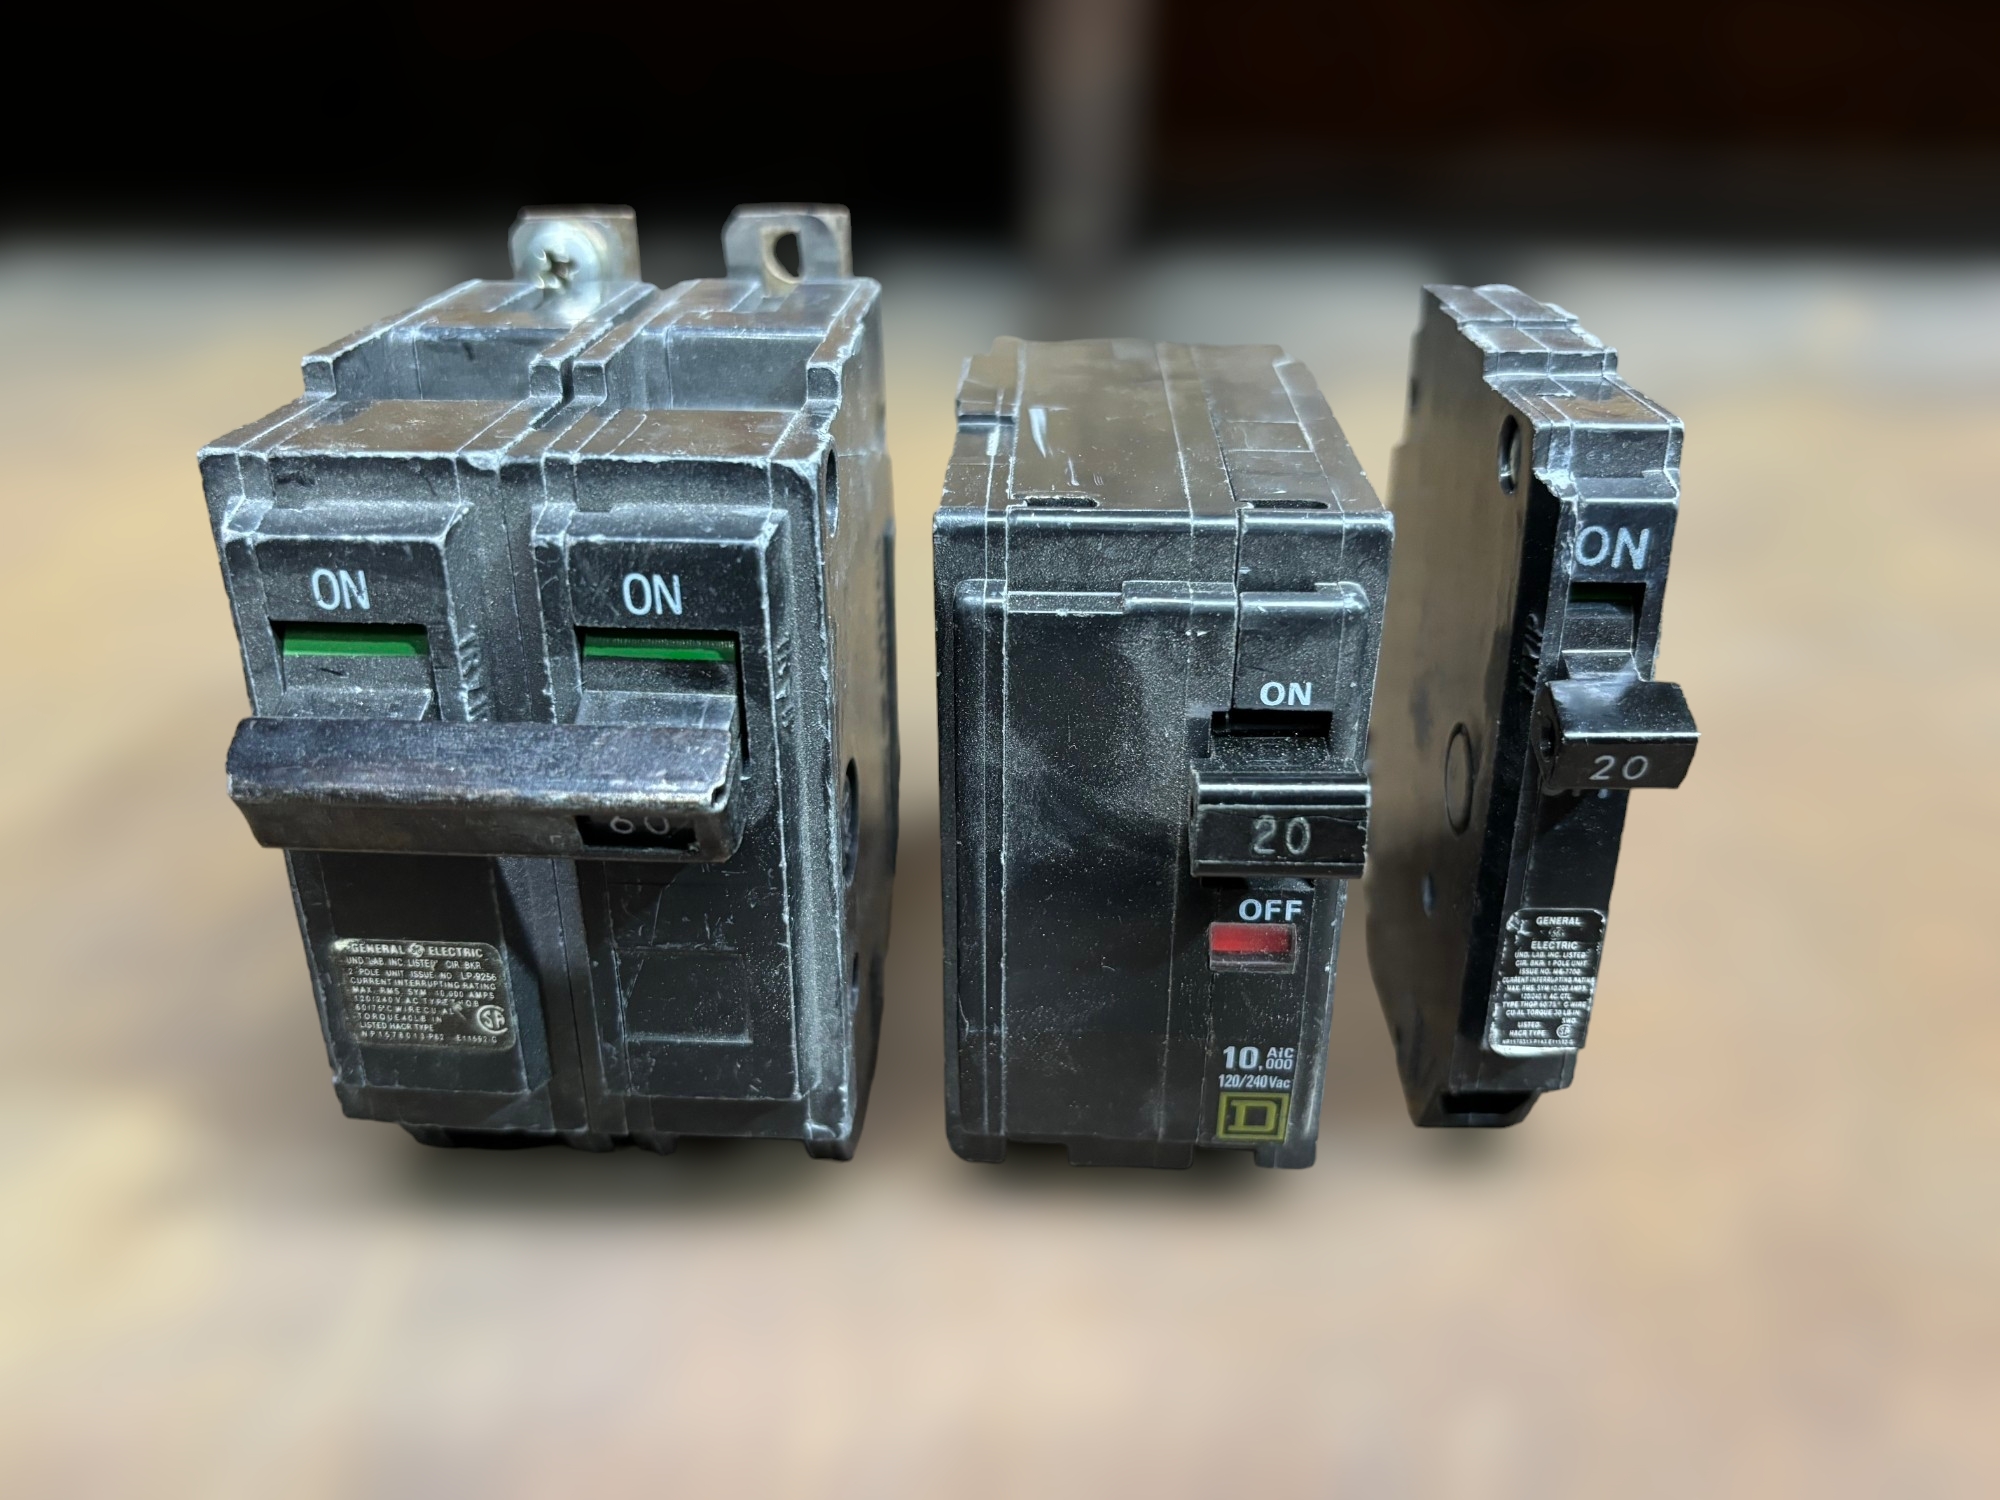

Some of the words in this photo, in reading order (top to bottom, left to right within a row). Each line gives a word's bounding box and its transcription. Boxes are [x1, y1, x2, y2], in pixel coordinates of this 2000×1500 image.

[1575, 525, 1650, 570] ON
[312, 568, 370, 611] ON
[623, 572, 682, 615] ON
[1260, 682, 1312, 706] ON
[1589, 755, 1649, 781] 20
[1253, 815, 1311, 855] 20
[1239, 898, 1303, 922] OFF
[1536, 916, 1582, 925] GENERAL
[351, 943, 406, 955] GENERAL
[428, 946, 484, 958] ELECTRIC
[1531, 940, 1579, 950] ELECTRIC
[358, 968, 381, 977] POLE
